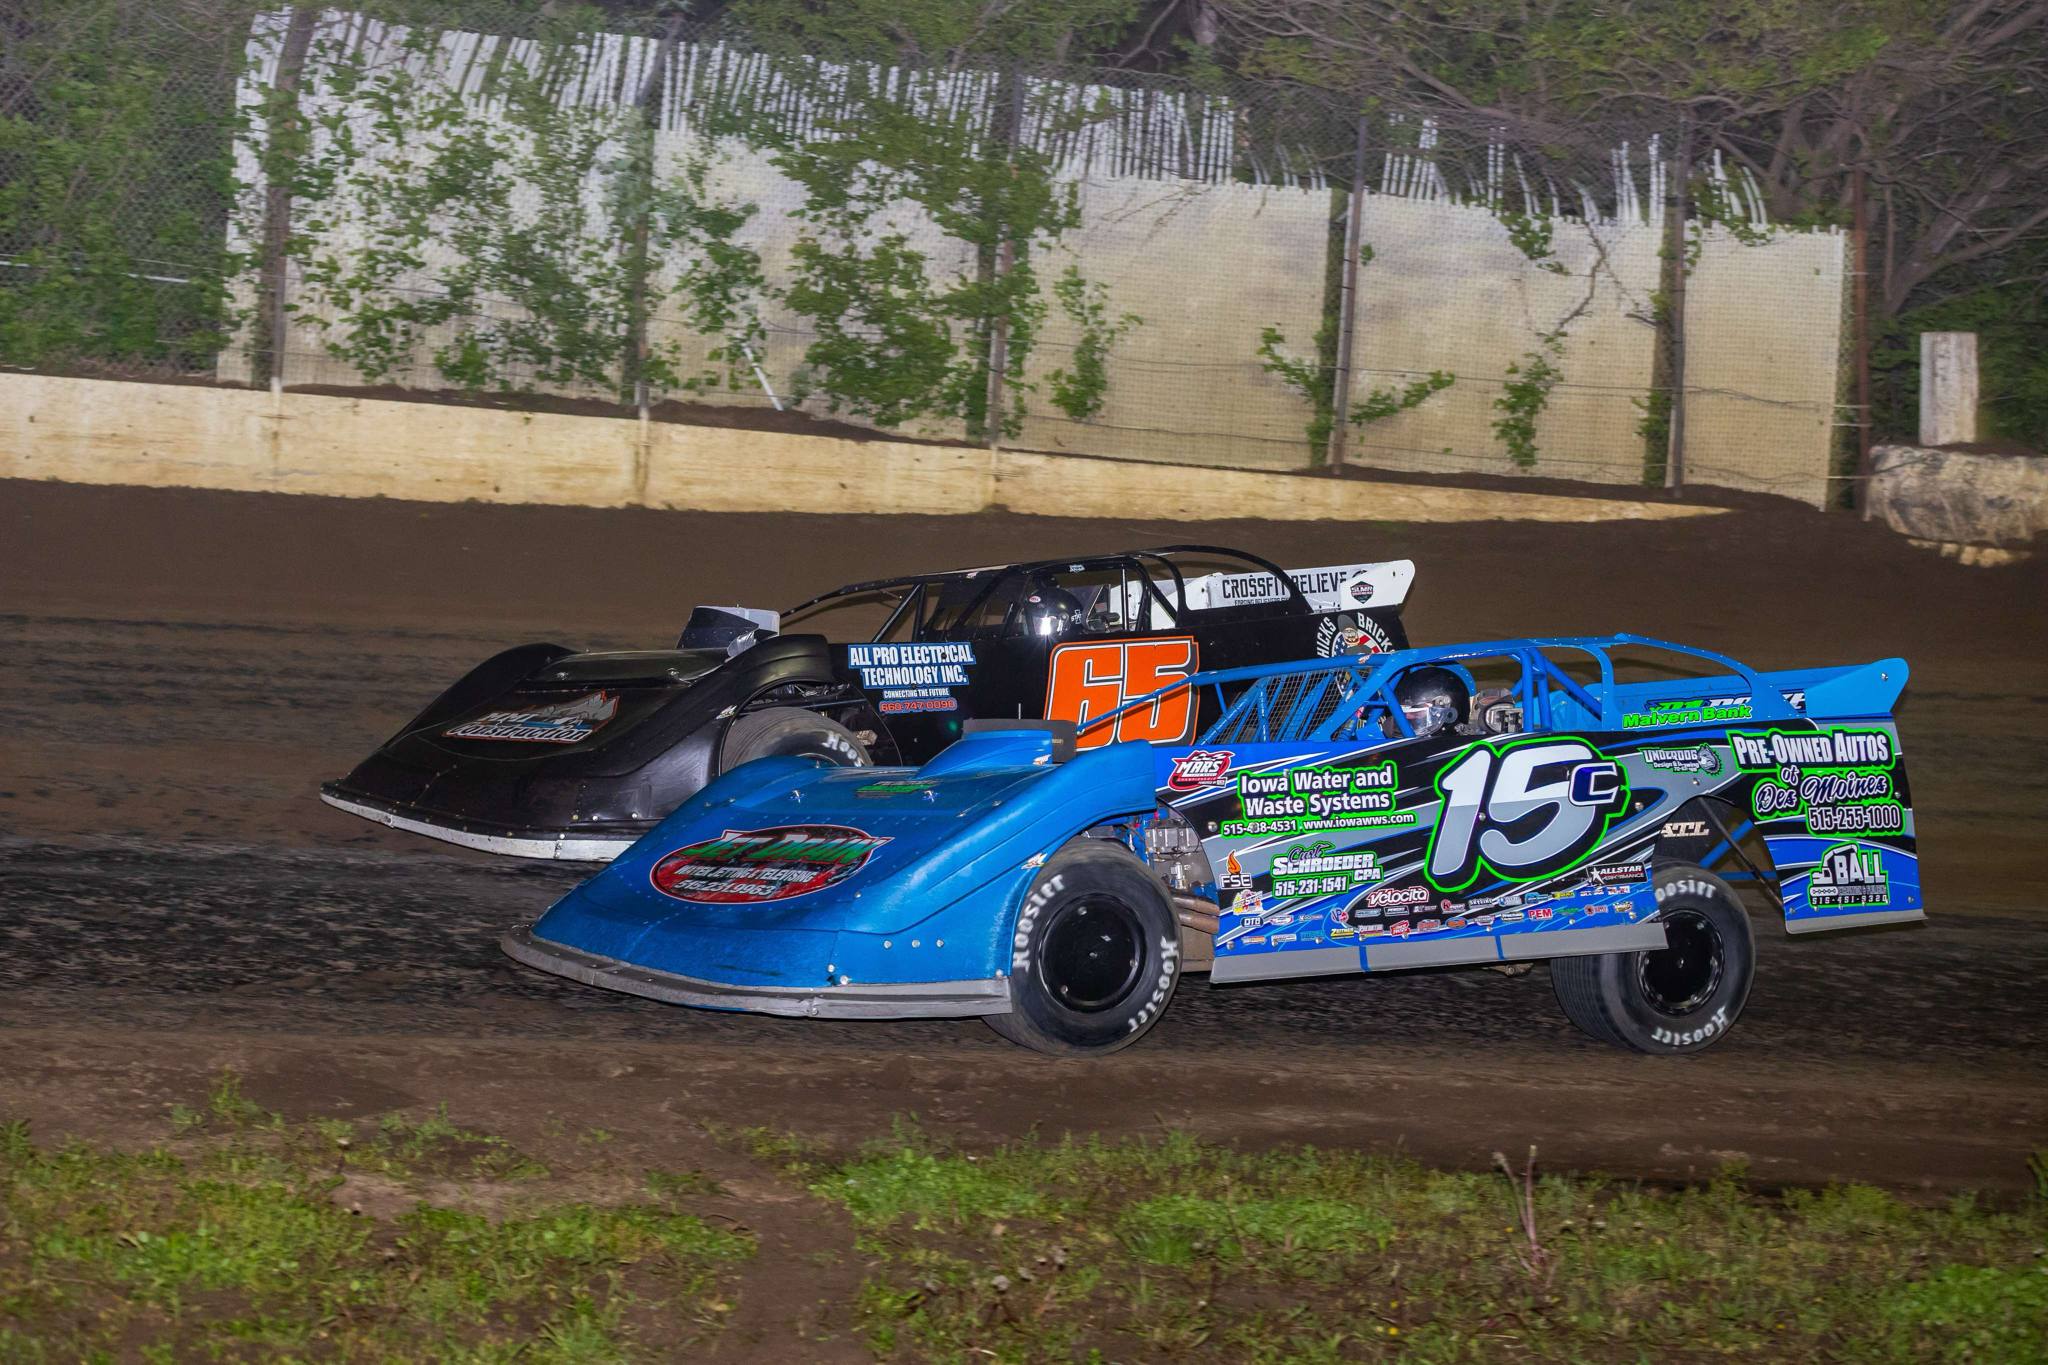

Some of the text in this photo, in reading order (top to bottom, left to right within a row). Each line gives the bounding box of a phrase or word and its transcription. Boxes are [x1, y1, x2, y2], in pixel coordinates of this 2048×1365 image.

[1222, 576, 1286, 599] CROSSFIT
[1316, 616, 1337, 659] HICKS
[850, 644, 974, 666] ALL PRO ELECTRICAL
[862, 664, 967, 686] TECHNOLOGY INC.
[884, 687, 950, 699] CONNECTING THE FUTURE
[1046, 637, 1199, 751] 65
[1622, 705, 1752, 728] Malvern Bank
[1643, 749, 1698, 763] UNDERDOG
[1834, 732, 1889, 763] AUTOS
[1177, 760, 1223, 775] MARS
[1781, 765, 1800, 786] of
[1241, 765, 1392, 794] Iowa Water and
[1756, 771, 1887, 813] Des Moines
[1246, 792, 1390, 817] Waste Systems
[1303, 813, 1414, 831] www.iowawws.com
[1808, 804, 1900, 831] 515-255-1000
[1272, 854, 1374, 876] SCHROEDER
[1354, 868, 1381, 881] CPA
[1600, 865, 1642, 876] ALLSTAR
[1834, 852, 1886, 885] BALL
[1221, 875, 1251, 888] FSE
[1275, 876, 1347, 897] 515-231-1541
[1655, 879, 1717, 902] OOSIER
[1528, 908, 1552, 919] PEM
